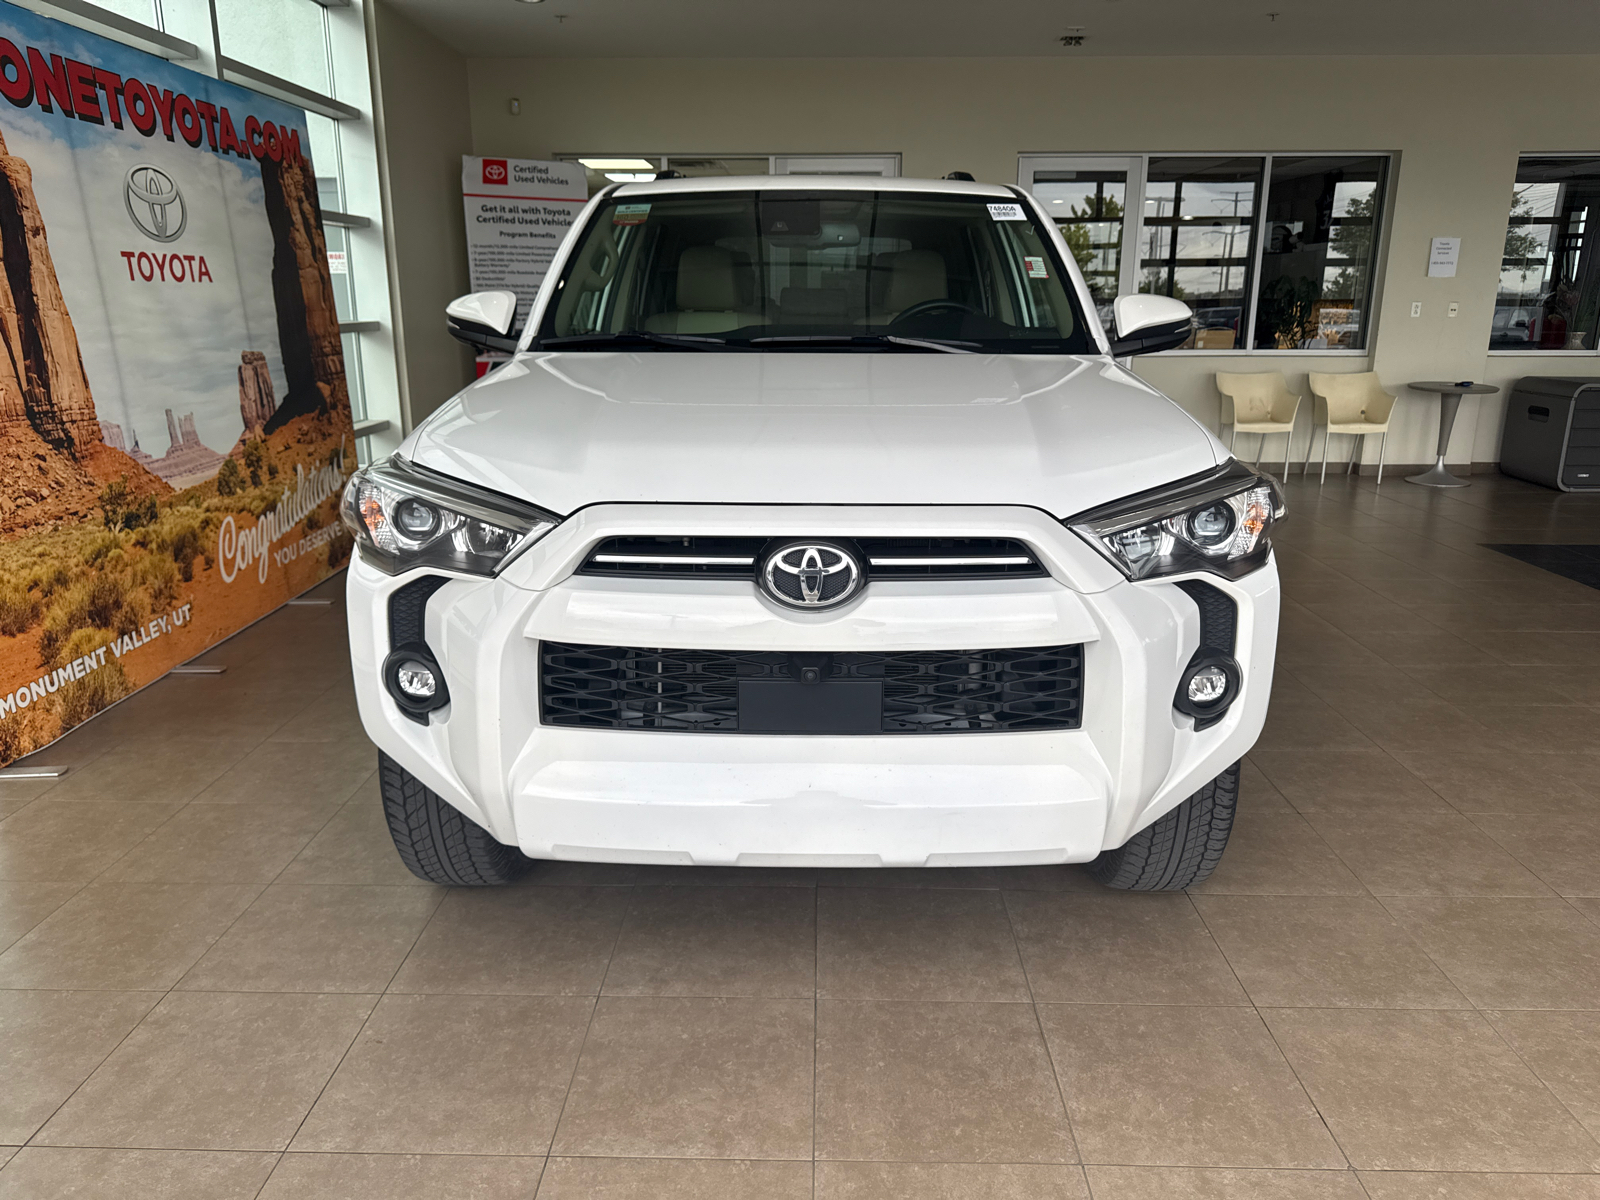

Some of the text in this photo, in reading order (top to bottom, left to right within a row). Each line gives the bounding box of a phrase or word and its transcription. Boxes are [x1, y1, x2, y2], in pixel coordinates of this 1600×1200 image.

[513, 165, 549, 175] Certified
[514, 175, 569, 186] Used Vehicles
[481, 205, 570, 217] Get it all with Toyota
[476, 214, 515, 224] Certified
[517, 216, 540, 225] Used
[500, 230, 556, 240] Program Benefits
[120, 251, 213, 283] TOYOTA
[218, 433, 347, 584] Congratulations!
[273, 520, 342, 568] YOU DESERVE
[0, 604, 192, 720] MONUMENT VALLEY, UT
